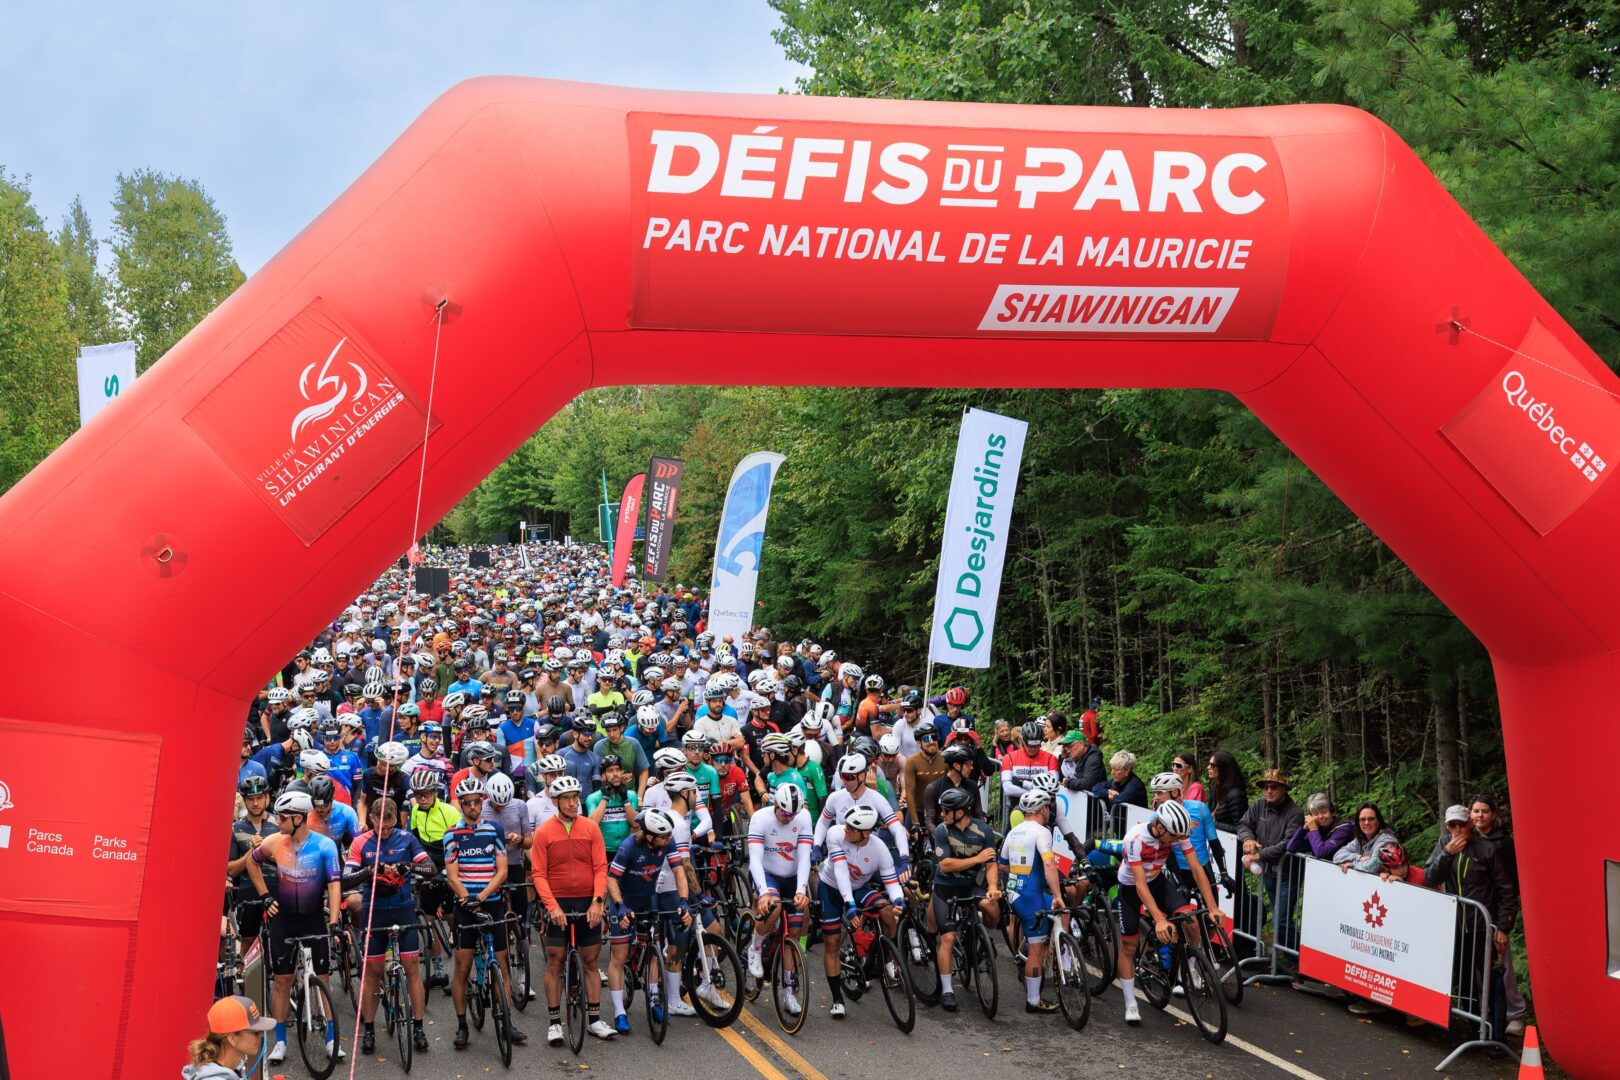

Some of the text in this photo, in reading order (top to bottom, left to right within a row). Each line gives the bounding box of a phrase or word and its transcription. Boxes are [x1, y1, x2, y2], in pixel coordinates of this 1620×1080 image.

[646, 126, 1268, 215] DÉFIS DU PARC
[643, 218, 1252, 270] PARC NATIONAL DE LA MAURICIE
[996, 292, 1221, 326] SHAWINIGAN
[1502, 371, 1576, 455] Québec
[265, 376, 397, 496] SHAWINIGAN
[279, 391, 405, 507] UN COURANT D'ÉNERGIES
[256, 447, 297, 483] VILLE DE
[649, 481, 665, 519] PARC
[955, 432, 1007, 598] Desjardins
[651, 519, 660, 533] DU
[27, 841, 74, 856] Canada
[28, 828, 62, 842] Parcs
[94, 835, 127, 848] Parks
[92, 848, 137, 861] Canada
[1339, 923, 1409, 954] PATROUILLE CANADIENNE DE SKI
[1351, 939, 1371, 954] CANADIAN
[1371, 945, 1379, 957] SKI
[1345, 963, 1368, 980] DÉFIS
[1373, 974, 1397, 990] PARC
